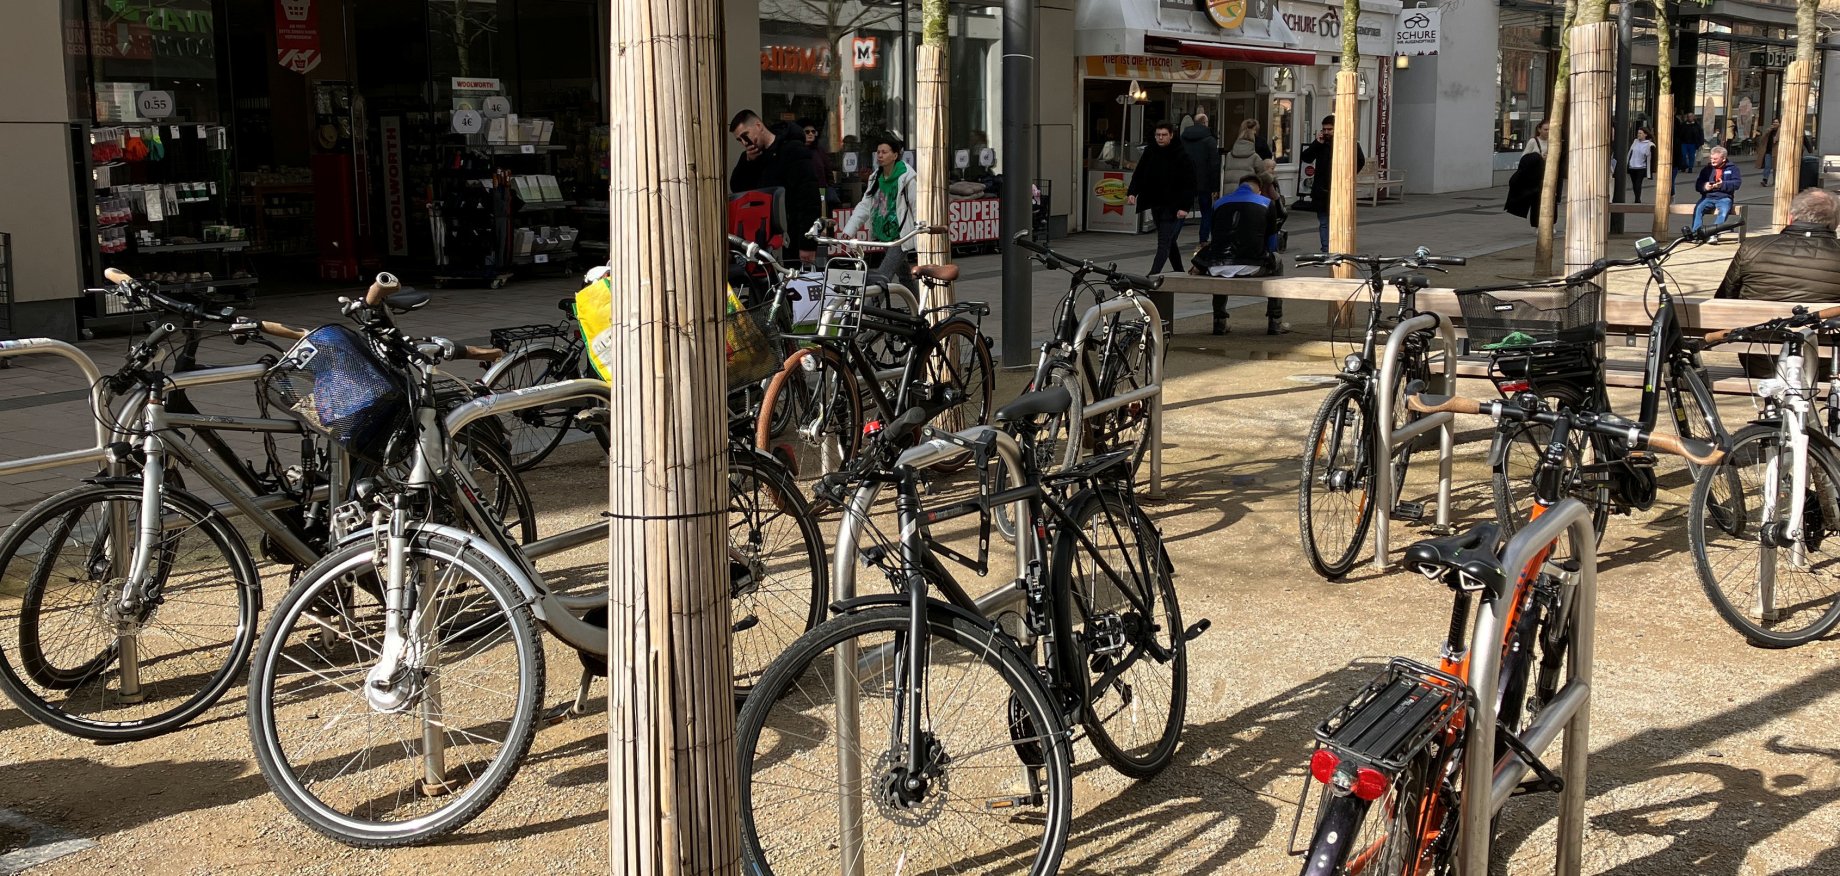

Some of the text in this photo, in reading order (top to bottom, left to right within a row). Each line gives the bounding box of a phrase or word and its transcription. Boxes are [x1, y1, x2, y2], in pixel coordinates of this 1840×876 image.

[1397, 31, 1436, 40] SCHURE
[857, 46, 870, 59] M
[144, 100, 166, 110] 0.55
[492, 104, 502, 112] 4€
[462, 118, 472, 126] 4€
[386, 128, 404, 252] WOOLWORTH
[950, 200, 999, 222] SUPER
[950, 220, 1000, 242] SPAREN
